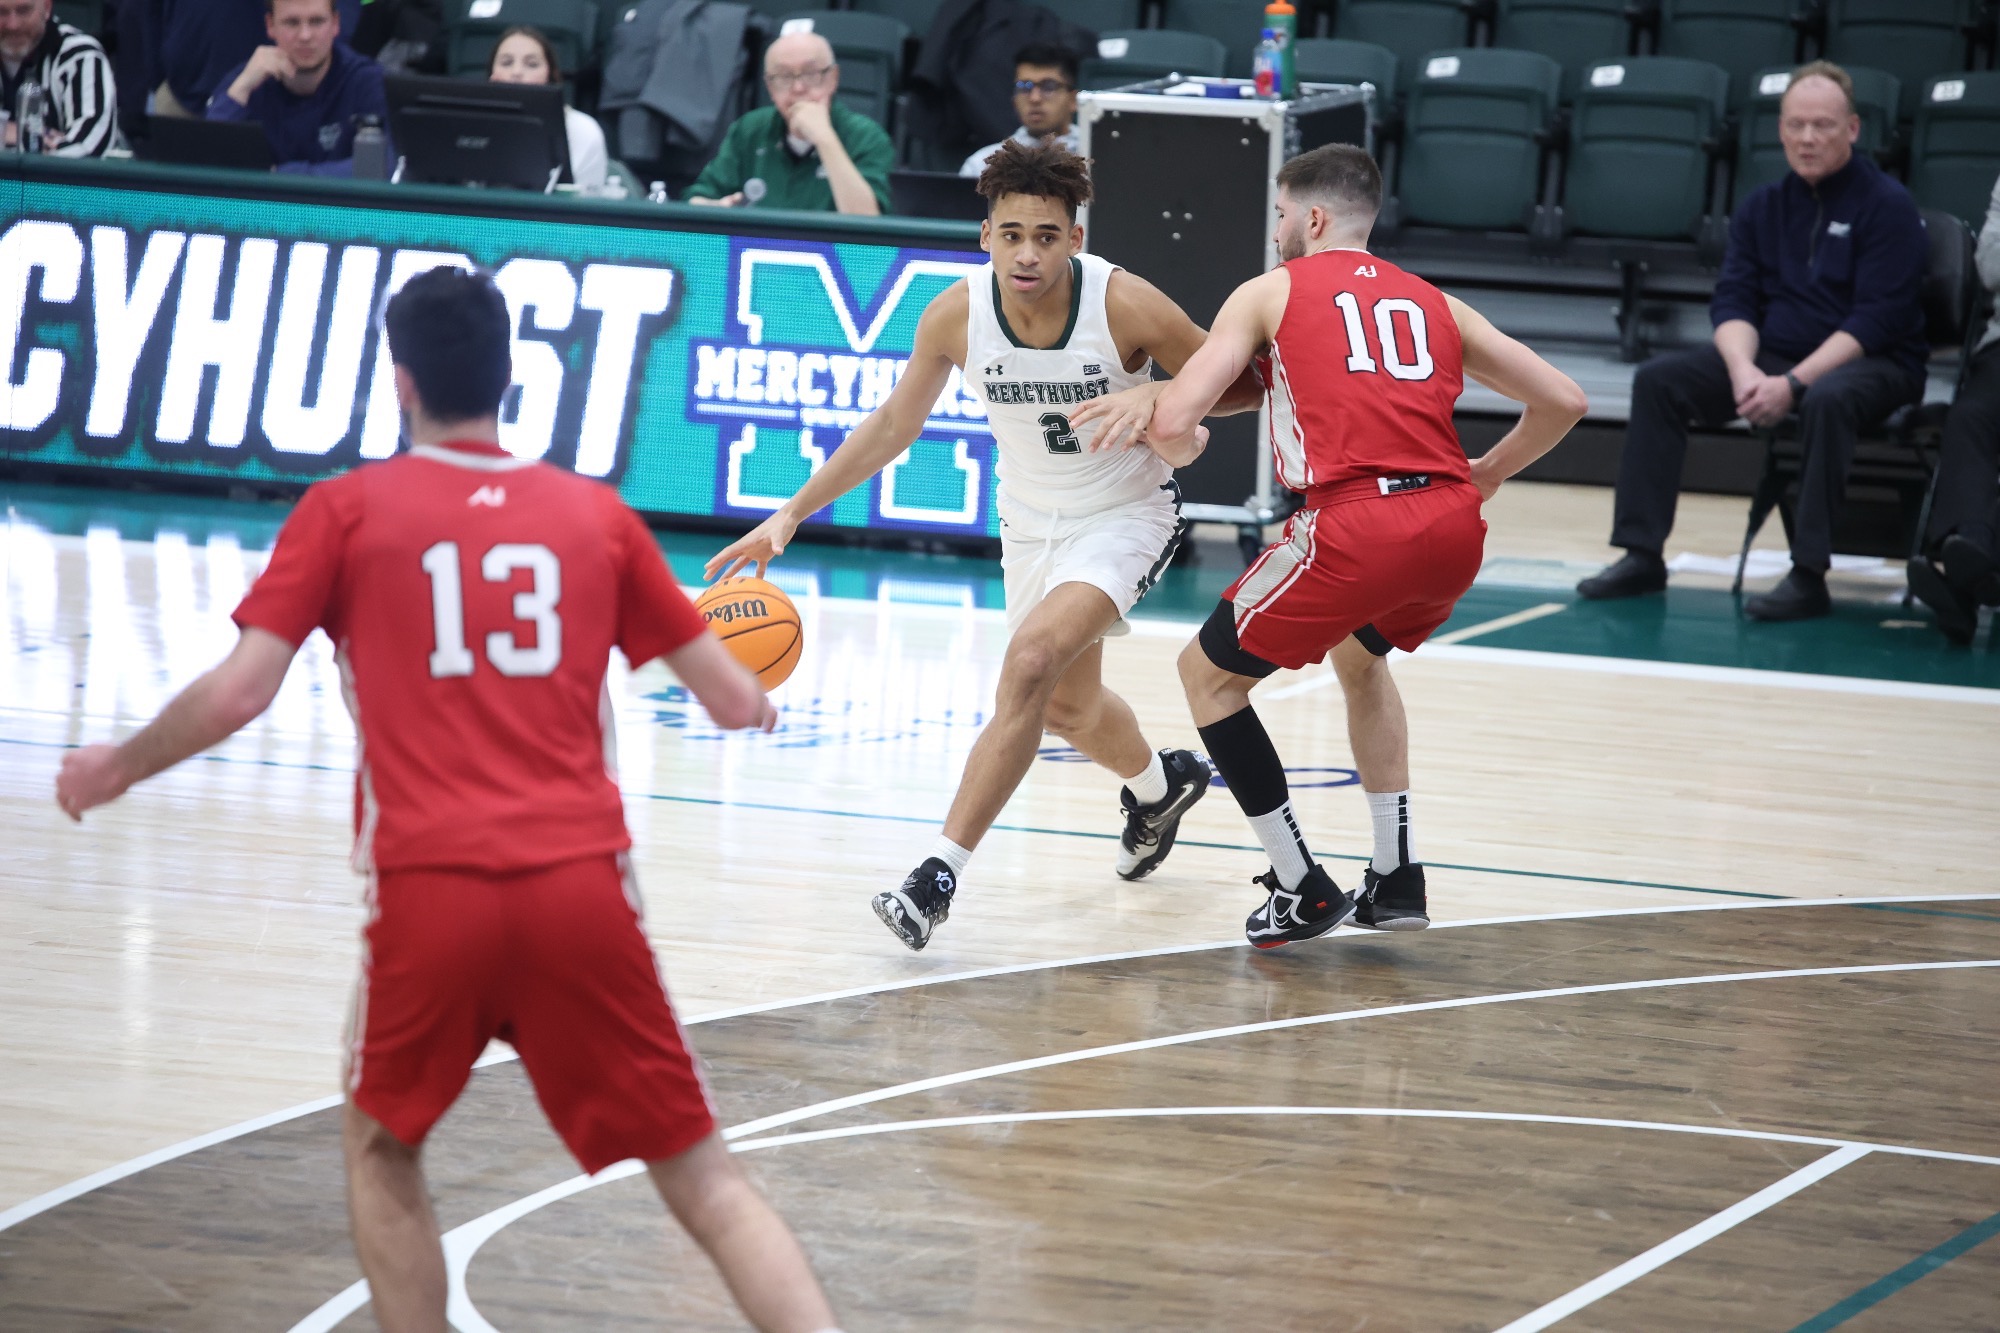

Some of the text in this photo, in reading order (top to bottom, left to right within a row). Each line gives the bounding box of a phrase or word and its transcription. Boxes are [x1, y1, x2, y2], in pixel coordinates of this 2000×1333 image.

[1333, 290, 1435, 382] 10
[983, 377, 1110, 405] MERCYHURST
[1038, 412, 1081, 454] 2
[421, 540, 562, 679] 13
[702, 598, 769, 624] Wilso
